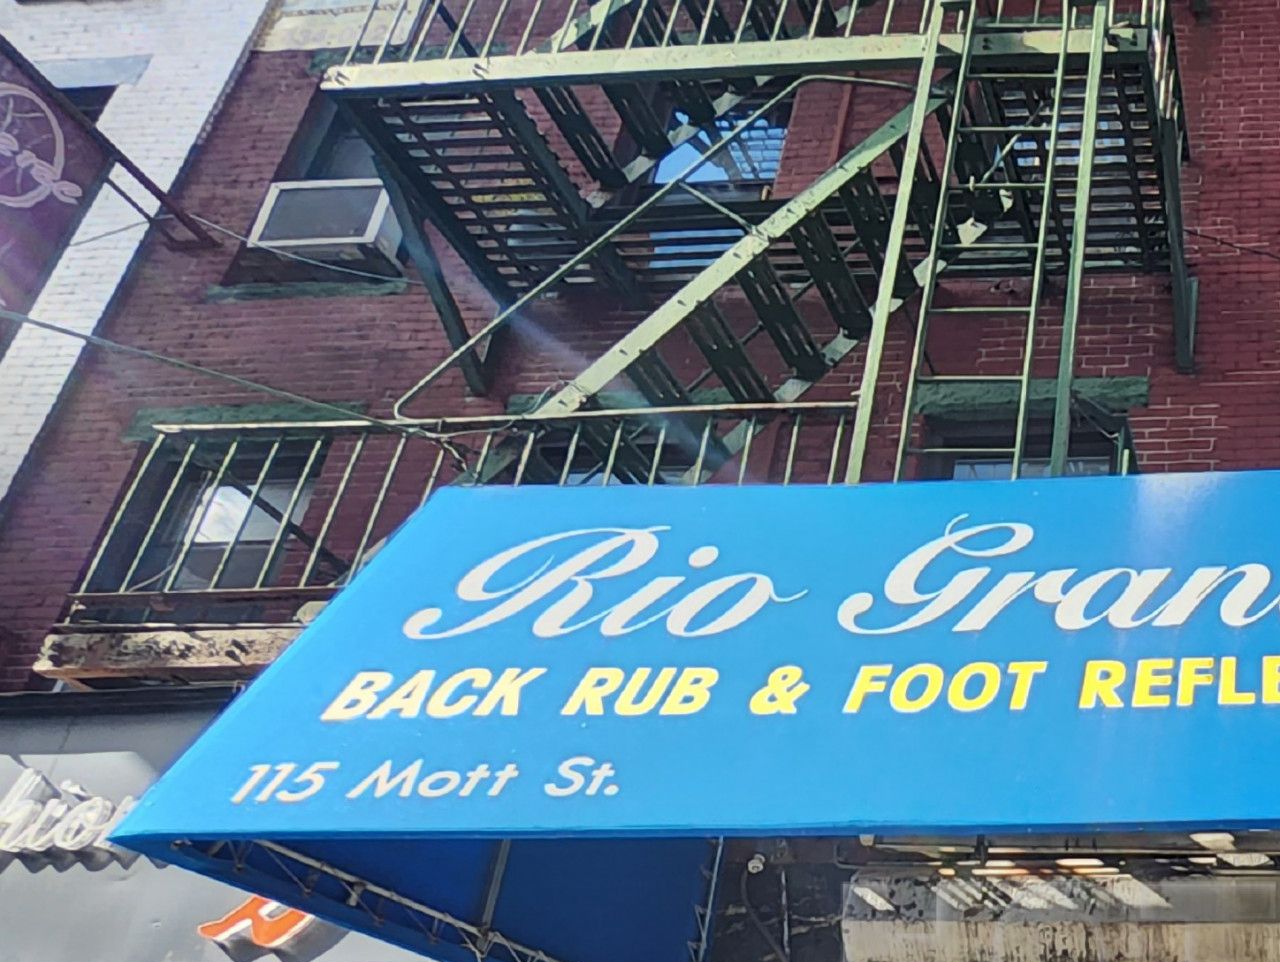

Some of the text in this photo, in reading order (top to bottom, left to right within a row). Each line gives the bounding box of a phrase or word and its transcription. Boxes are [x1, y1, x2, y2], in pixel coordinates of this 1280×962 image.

[403, 525, 808, 640] Rio
[320, 668, 547, 722] BACK
[561, 666, 719, 716] RUB
[749, 665, 810, 715] &
[842, 661, 1048, 713] FOOT
[231, 757, 620, 804] 115 Mott St.
